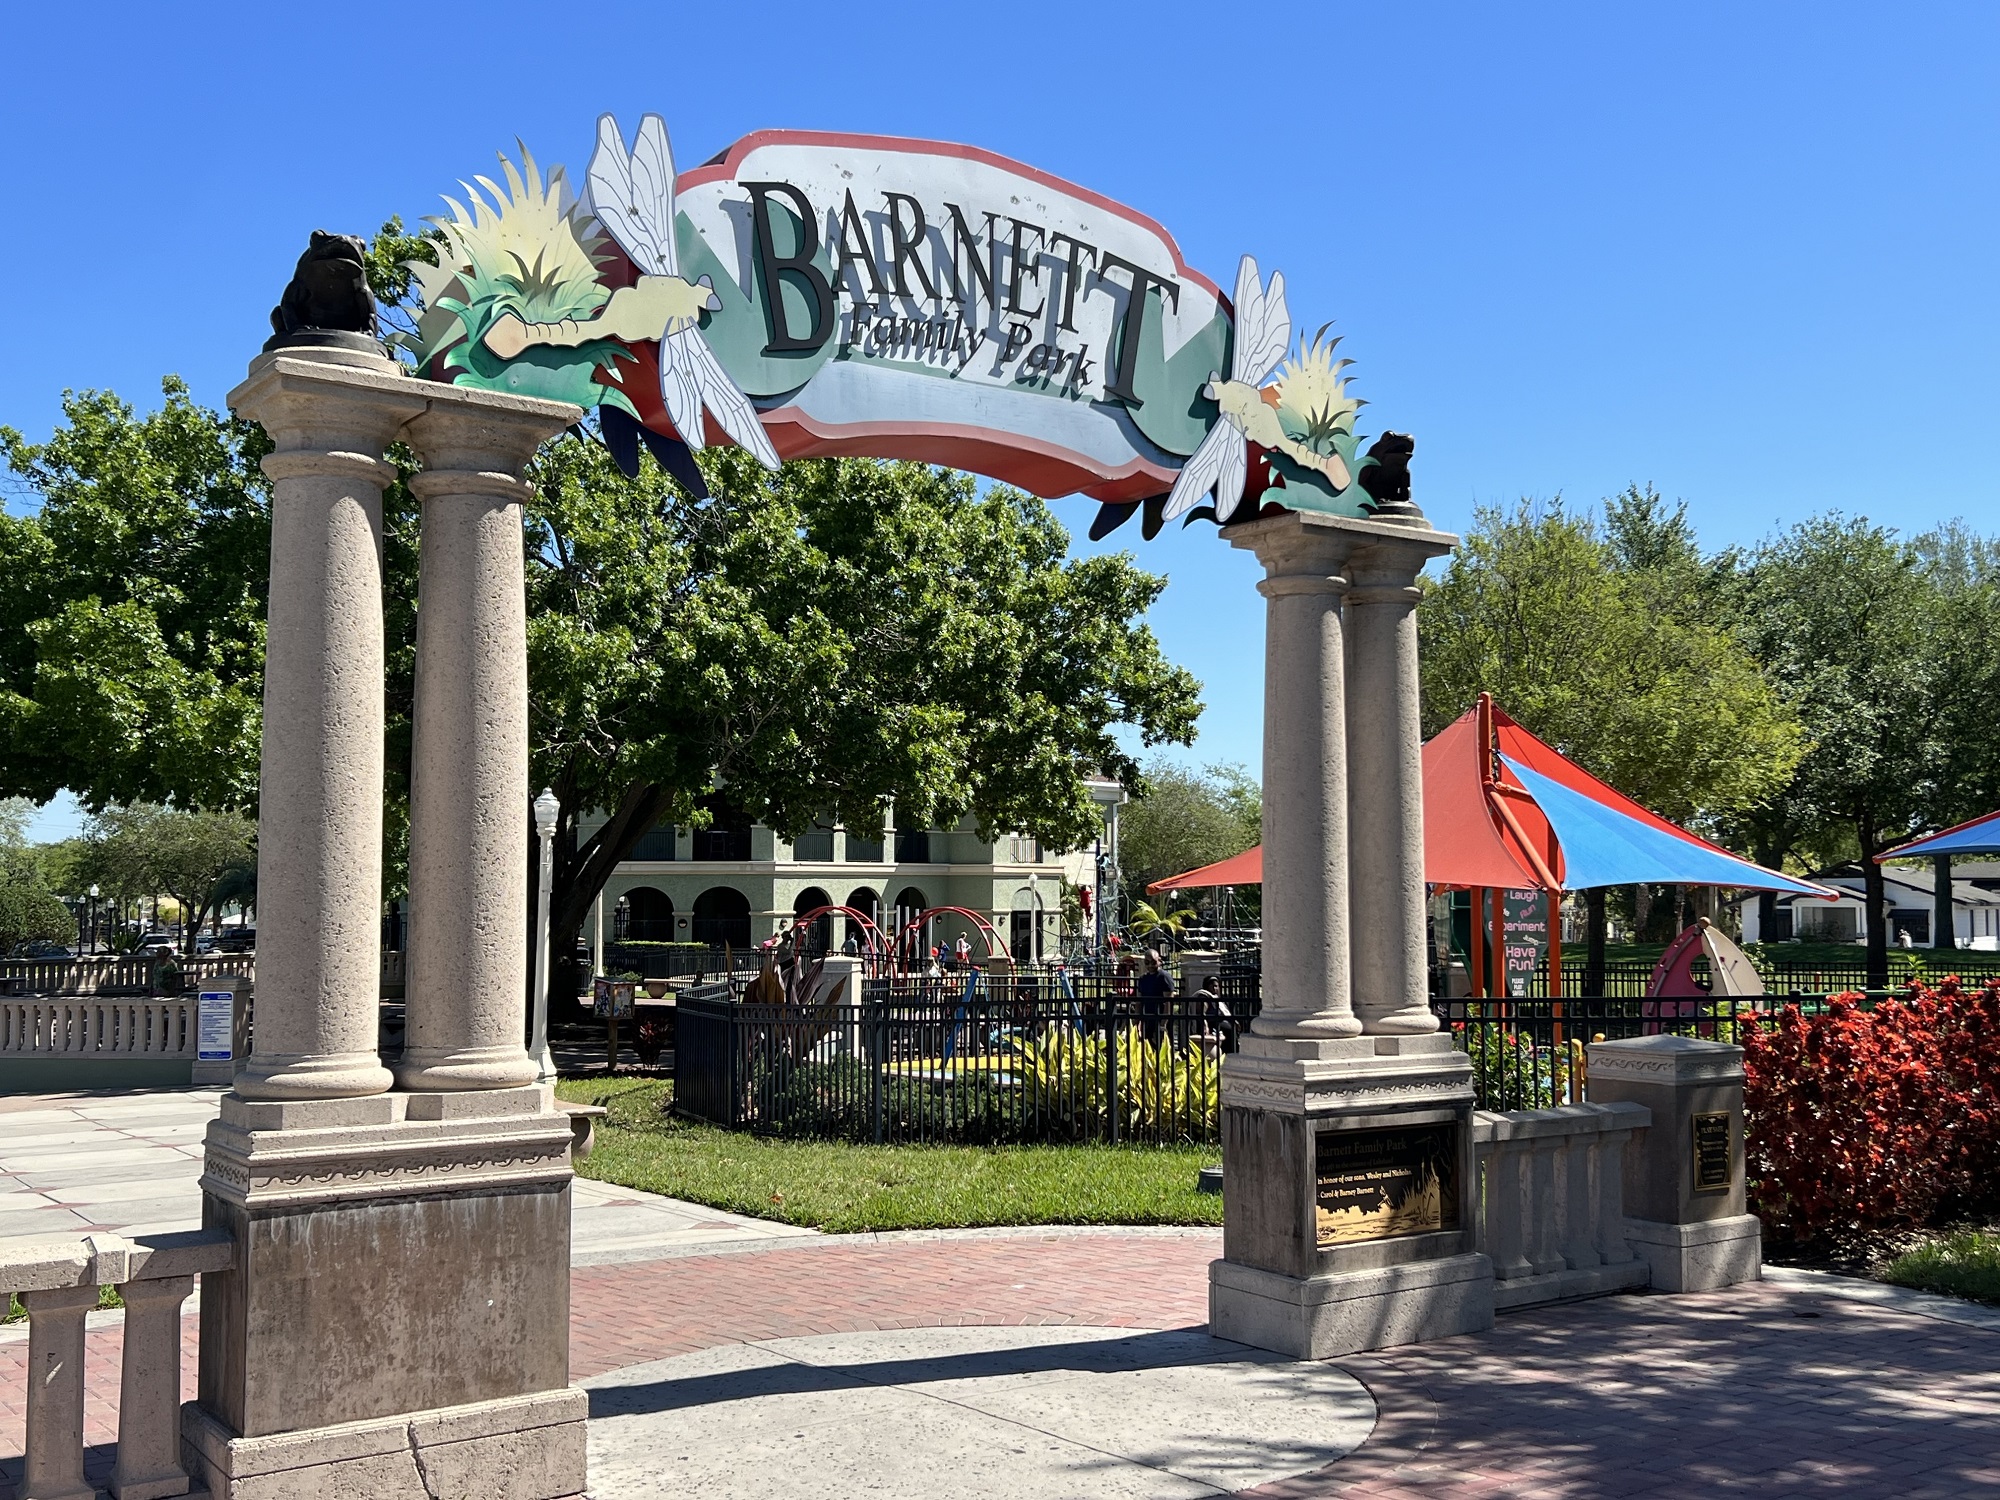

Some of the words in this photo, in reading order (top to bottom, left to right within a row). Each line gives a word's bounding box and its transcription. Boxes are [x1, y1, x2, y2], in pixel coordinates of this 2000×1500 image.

[738, 181, 1180, 407] BARNETT
[849, 301, 985, 368] Family
[1001, 321, 1096, 387] Park
[1510, 890, 1538, 902] Laugh
[1488, 920, 1546, 932] Eperiment
[1505, 946, 1536, 958] Have
[1317, 1145, 1352, 1157] Barnett
[1354, 1139, 1385, 1154] Family
[1386, 1138, 1407, 1151] Park
[1323, 1176, 1338, 1184] honor
[1338, 1174, 1345, 1184] of
[1382, 1170, 1391, 1178] and
[1320, 1190, 1334, 1198] Carol
[1334, 1190, 1339, 1199] &
[1339, 1189, 1356, 1197] Barney
[1356, 1187, 1374, 1195] Barnett
